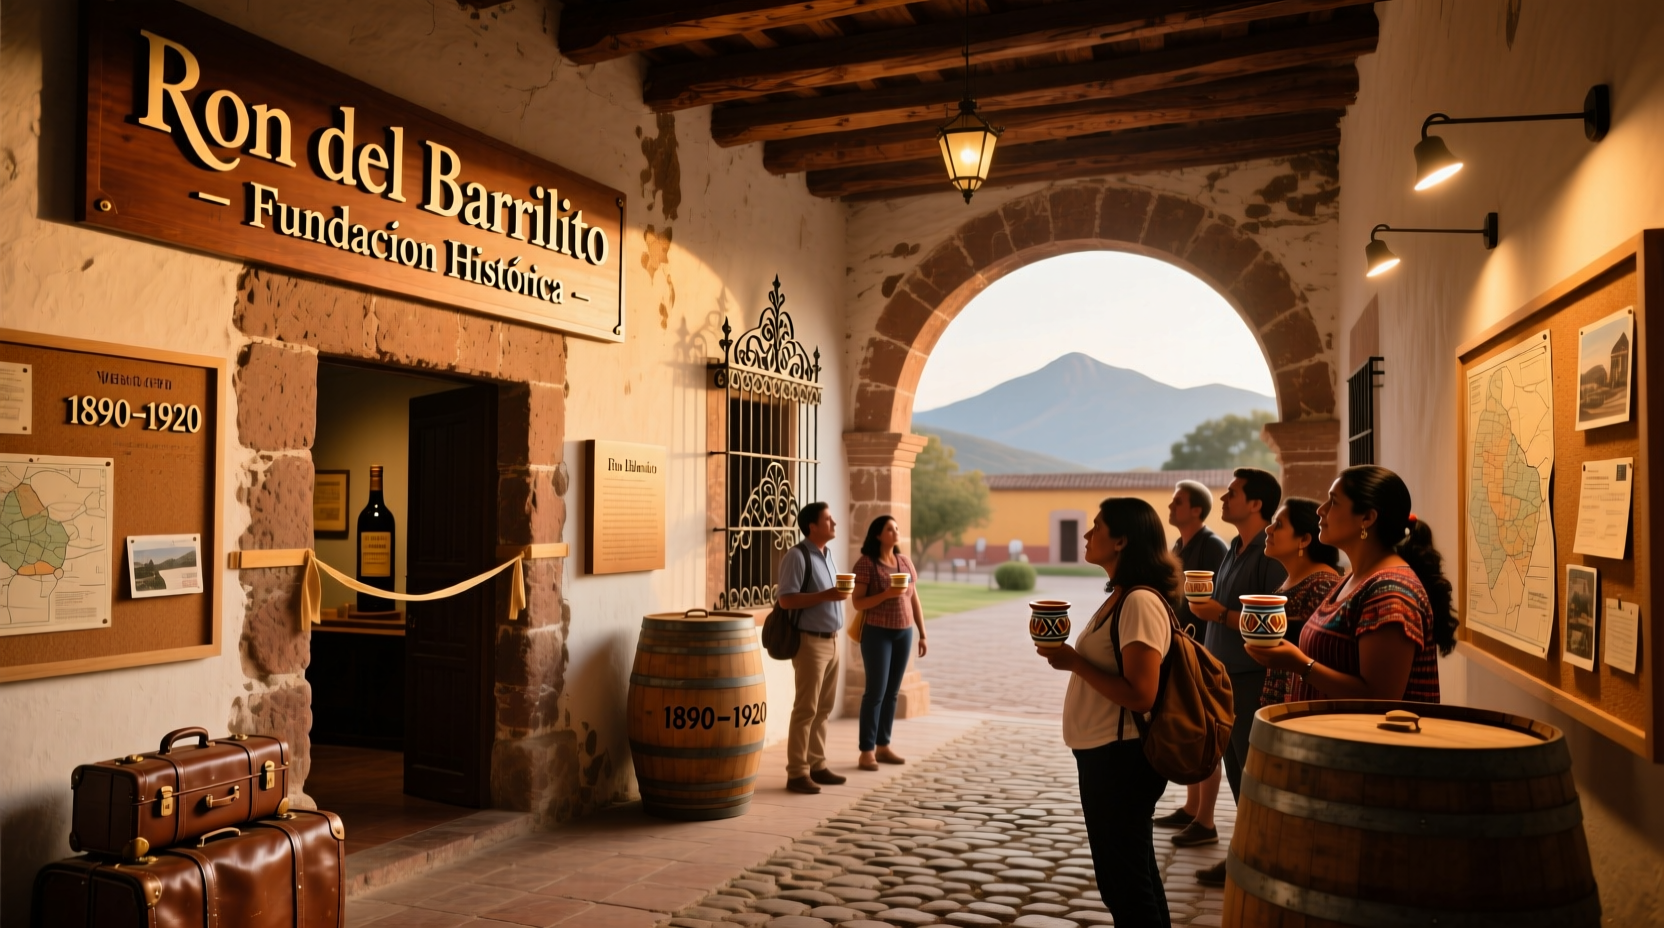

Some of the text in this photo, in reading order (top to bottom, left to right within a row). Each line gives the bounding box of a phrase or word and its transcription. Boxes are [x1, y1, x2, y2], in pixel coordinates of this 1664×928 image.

[139, 29, 609, 266] Ron del Barrilito
[448, 239, 565, 304] Histórica
